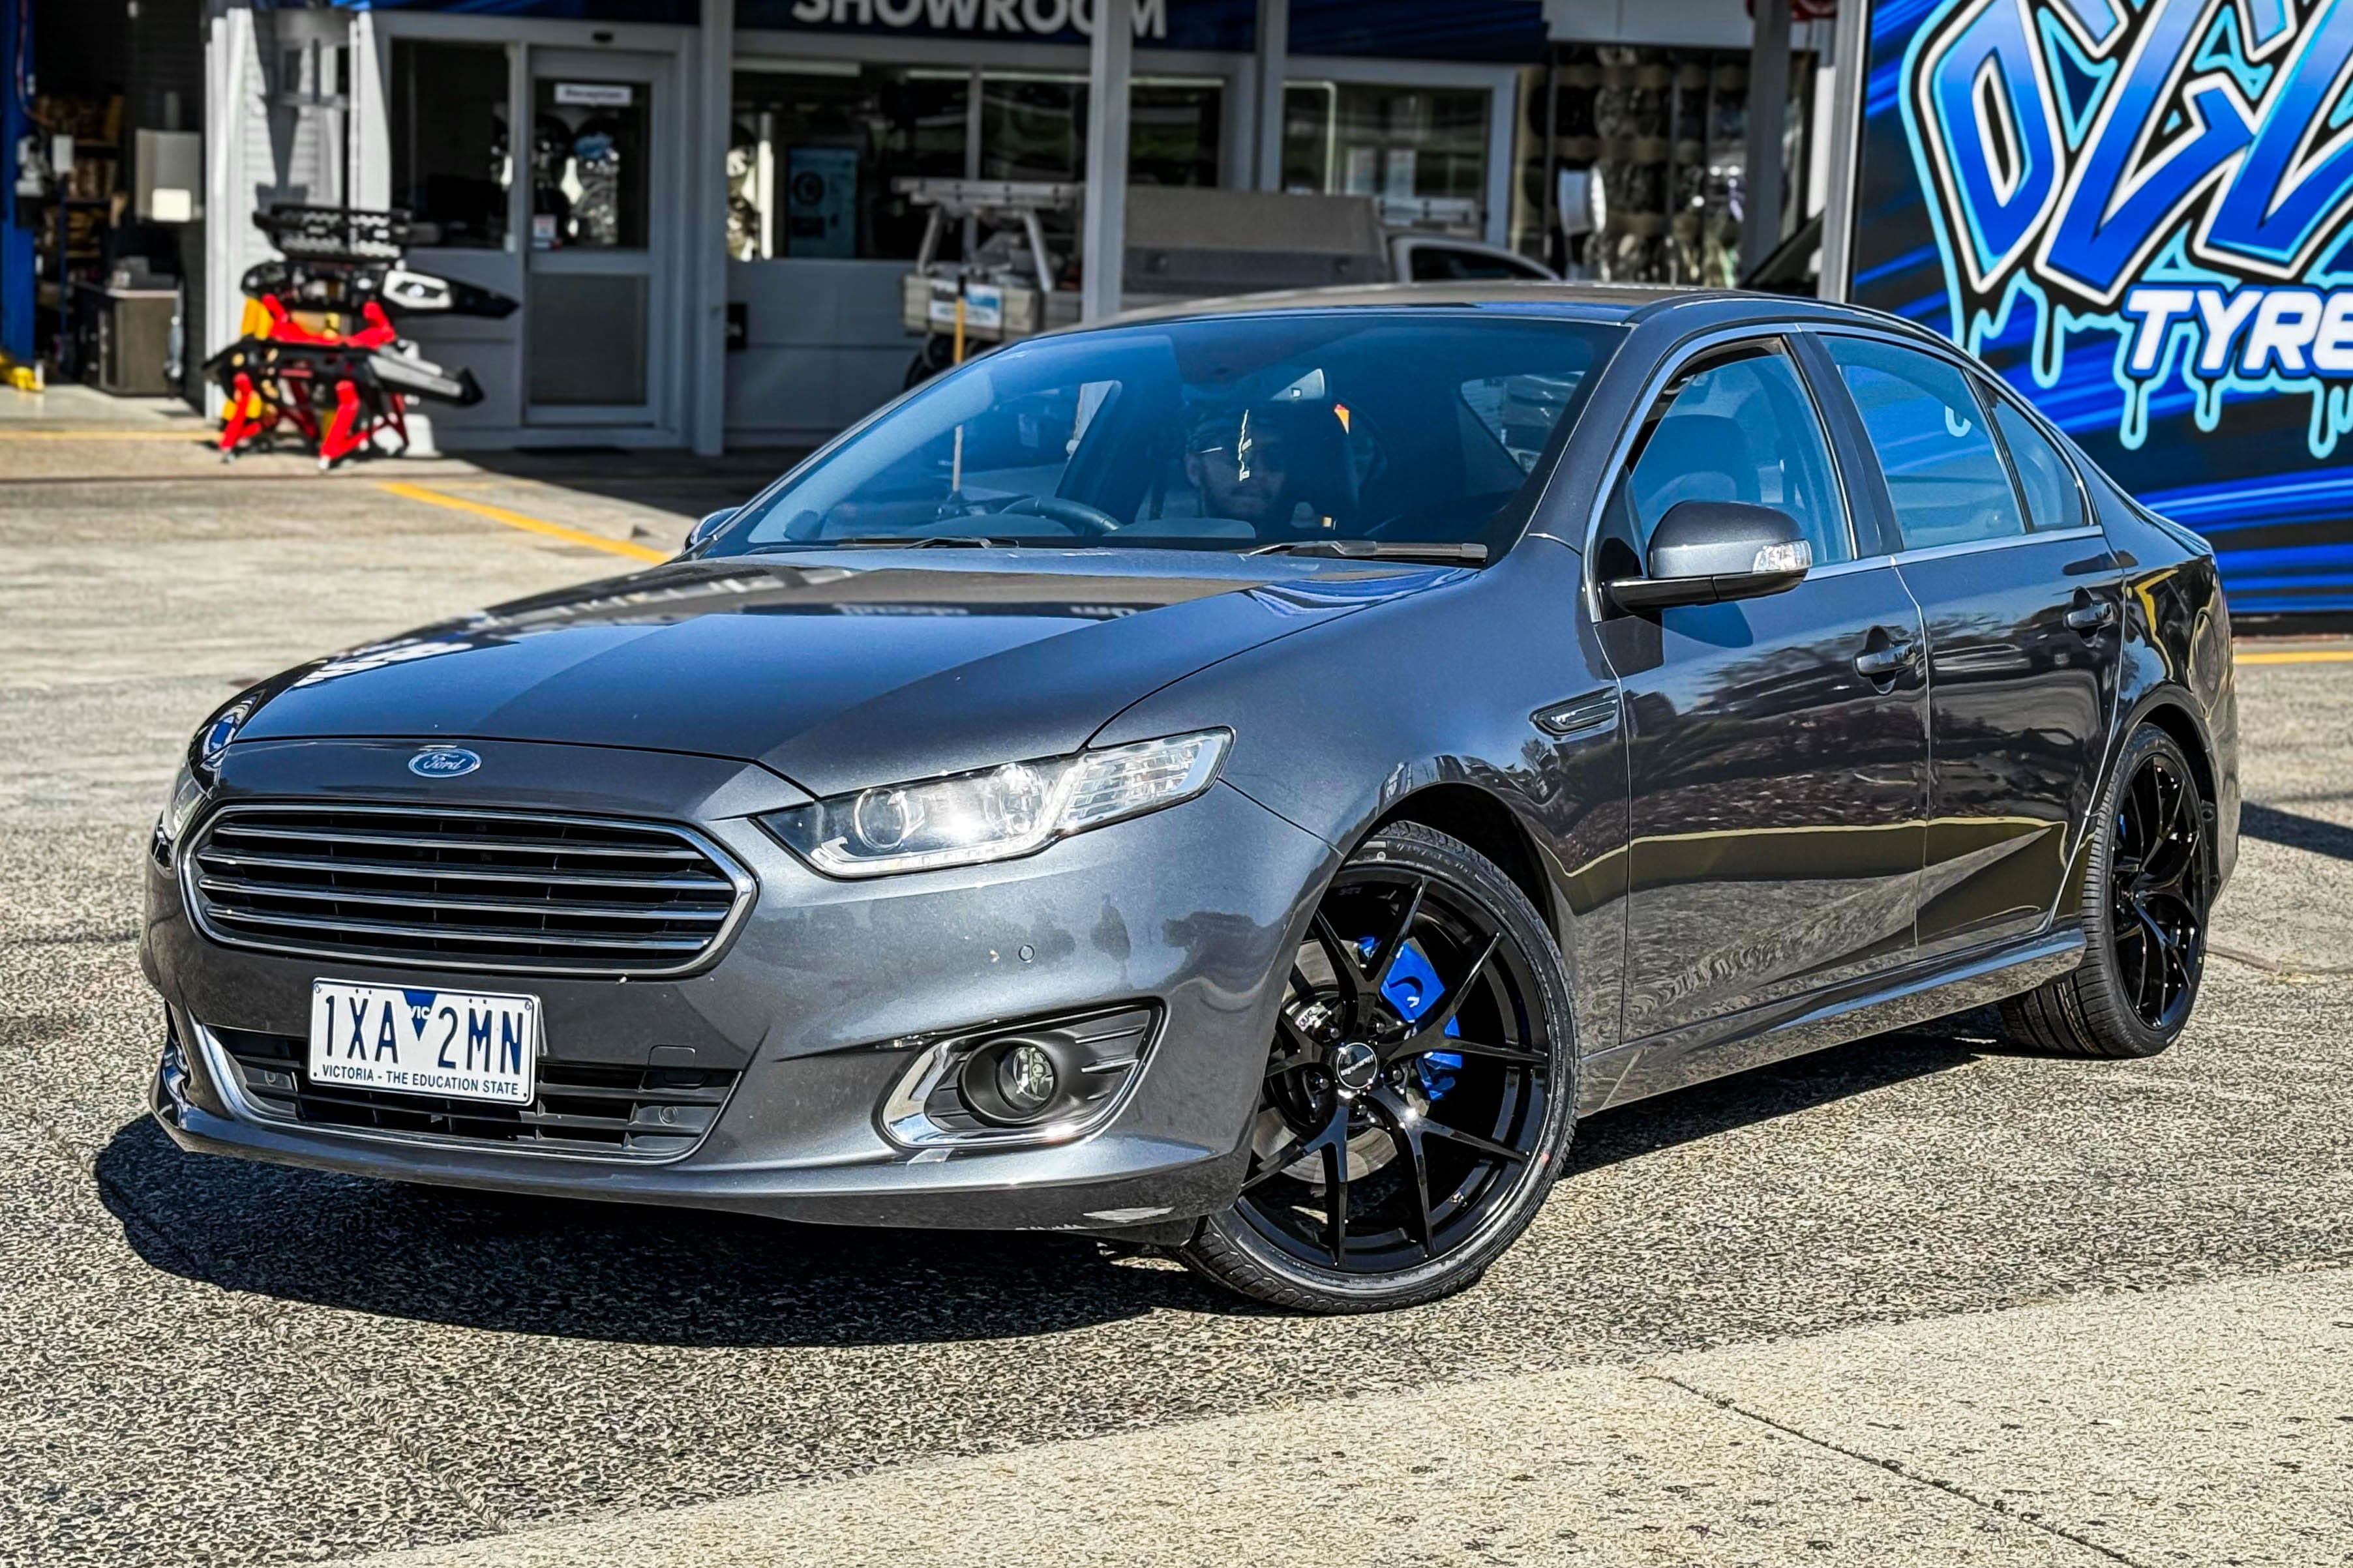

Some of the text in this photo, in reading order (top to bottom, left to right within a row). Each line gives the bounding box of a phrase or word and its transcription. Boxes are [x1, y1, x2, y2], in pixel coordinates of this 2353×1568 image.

[423, 753, 466, 770] Ford
[409, 1005, 431, 1020] VIC
[325, 995, 524, 1075] 1XA 2MN
[322, 1063, 375, 1082] VICTORIA
[386, 1071, 409, 1085] THE
[412, 1073, 479, 1091] EDUCATION
[483, 1080, 518, 1095] STATE
